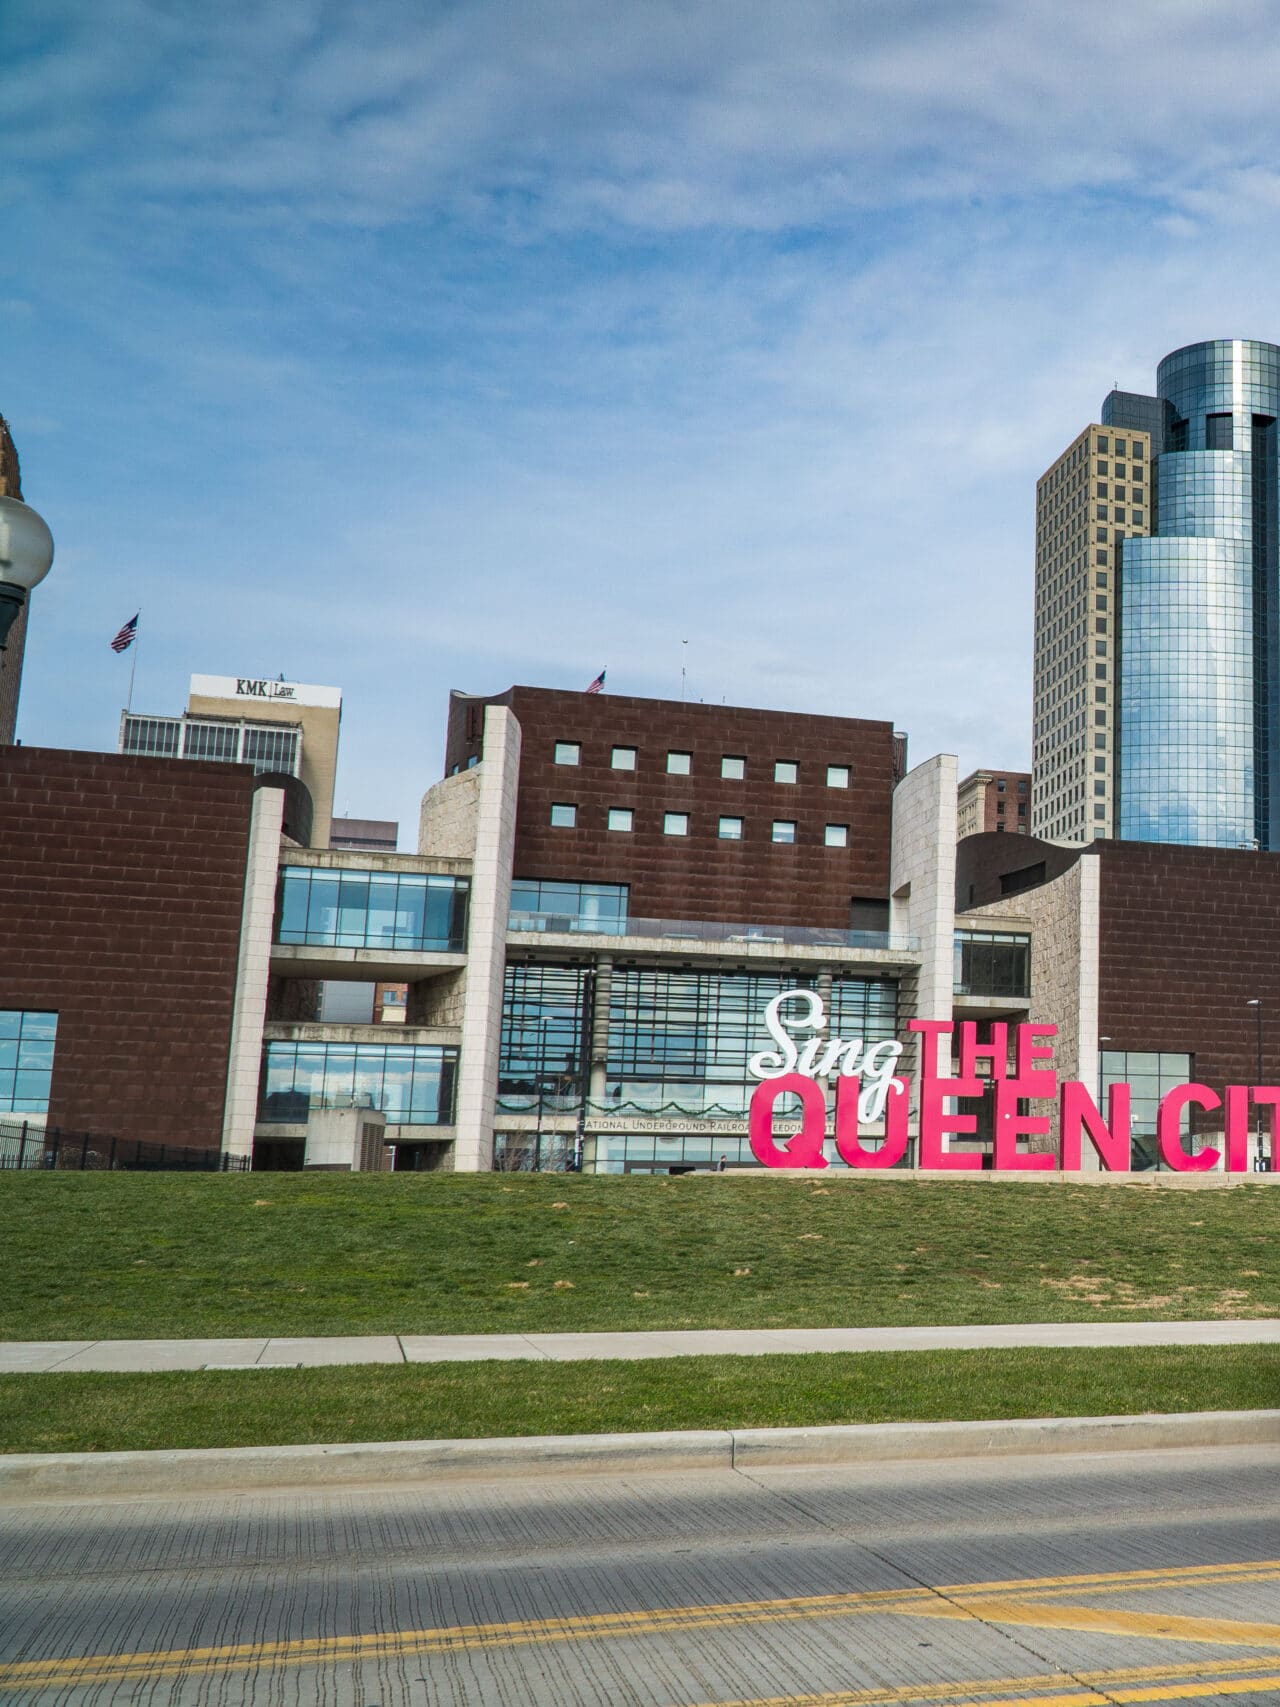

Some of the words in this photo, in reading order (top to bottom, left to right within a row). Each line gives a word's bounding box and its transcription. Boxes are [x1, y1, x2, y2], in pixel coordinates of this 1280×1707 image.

[236, 678, 268, 697] KMK
[274, 682, 295, 697] Law
[749, 989, 905, 1125] Sing
[906, 1019, 1058, 1081] THE
[584, 1119, 628, 1131] ATIONAL
[711, 1120, 750, 1132] RAILROA
[749, 1072, 1131, 1171] QUEEN
